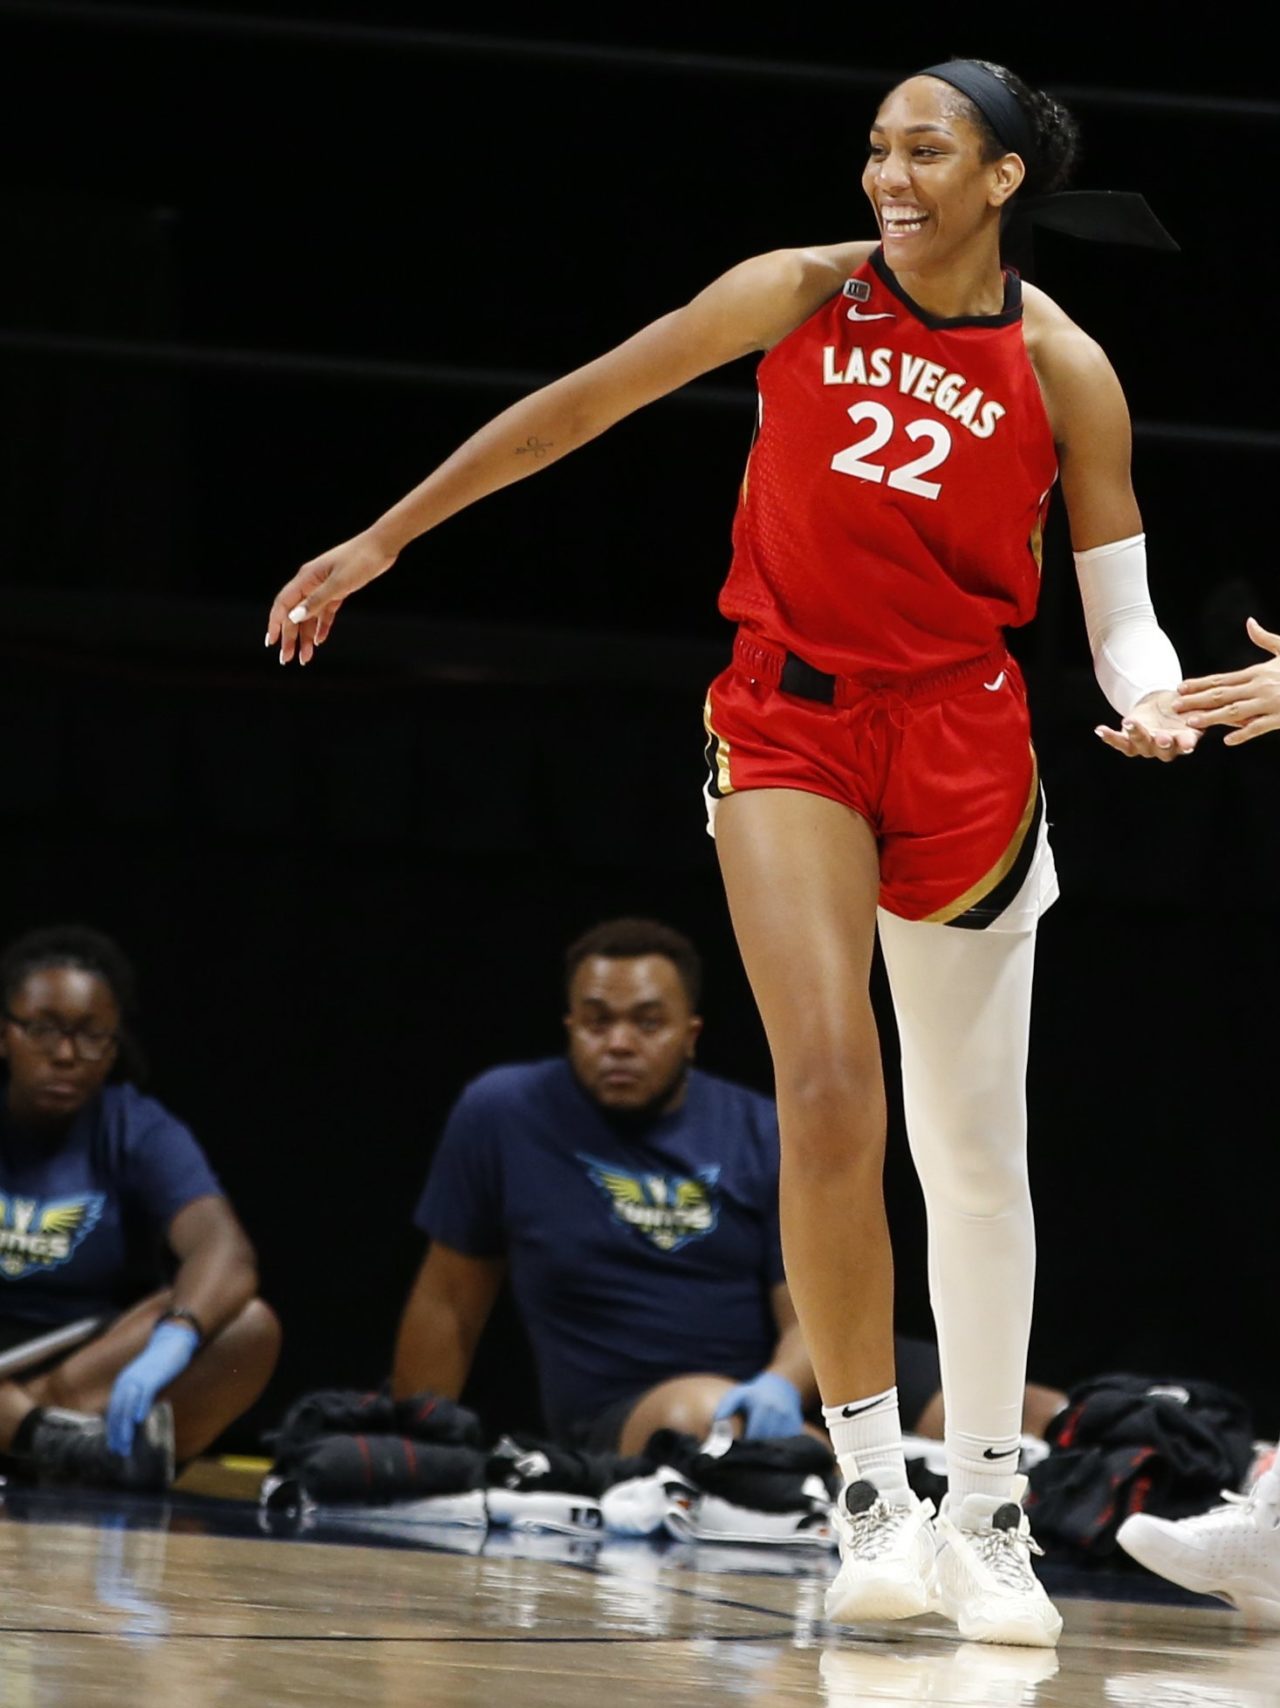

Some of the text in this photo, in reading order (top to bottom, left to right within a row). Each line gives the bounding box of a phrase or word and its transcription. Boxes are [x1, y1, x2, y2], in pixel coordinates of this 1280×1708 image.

[822, 346, 1006, 439] LAS VEGAS
[830, 400, 952, 501] 22
